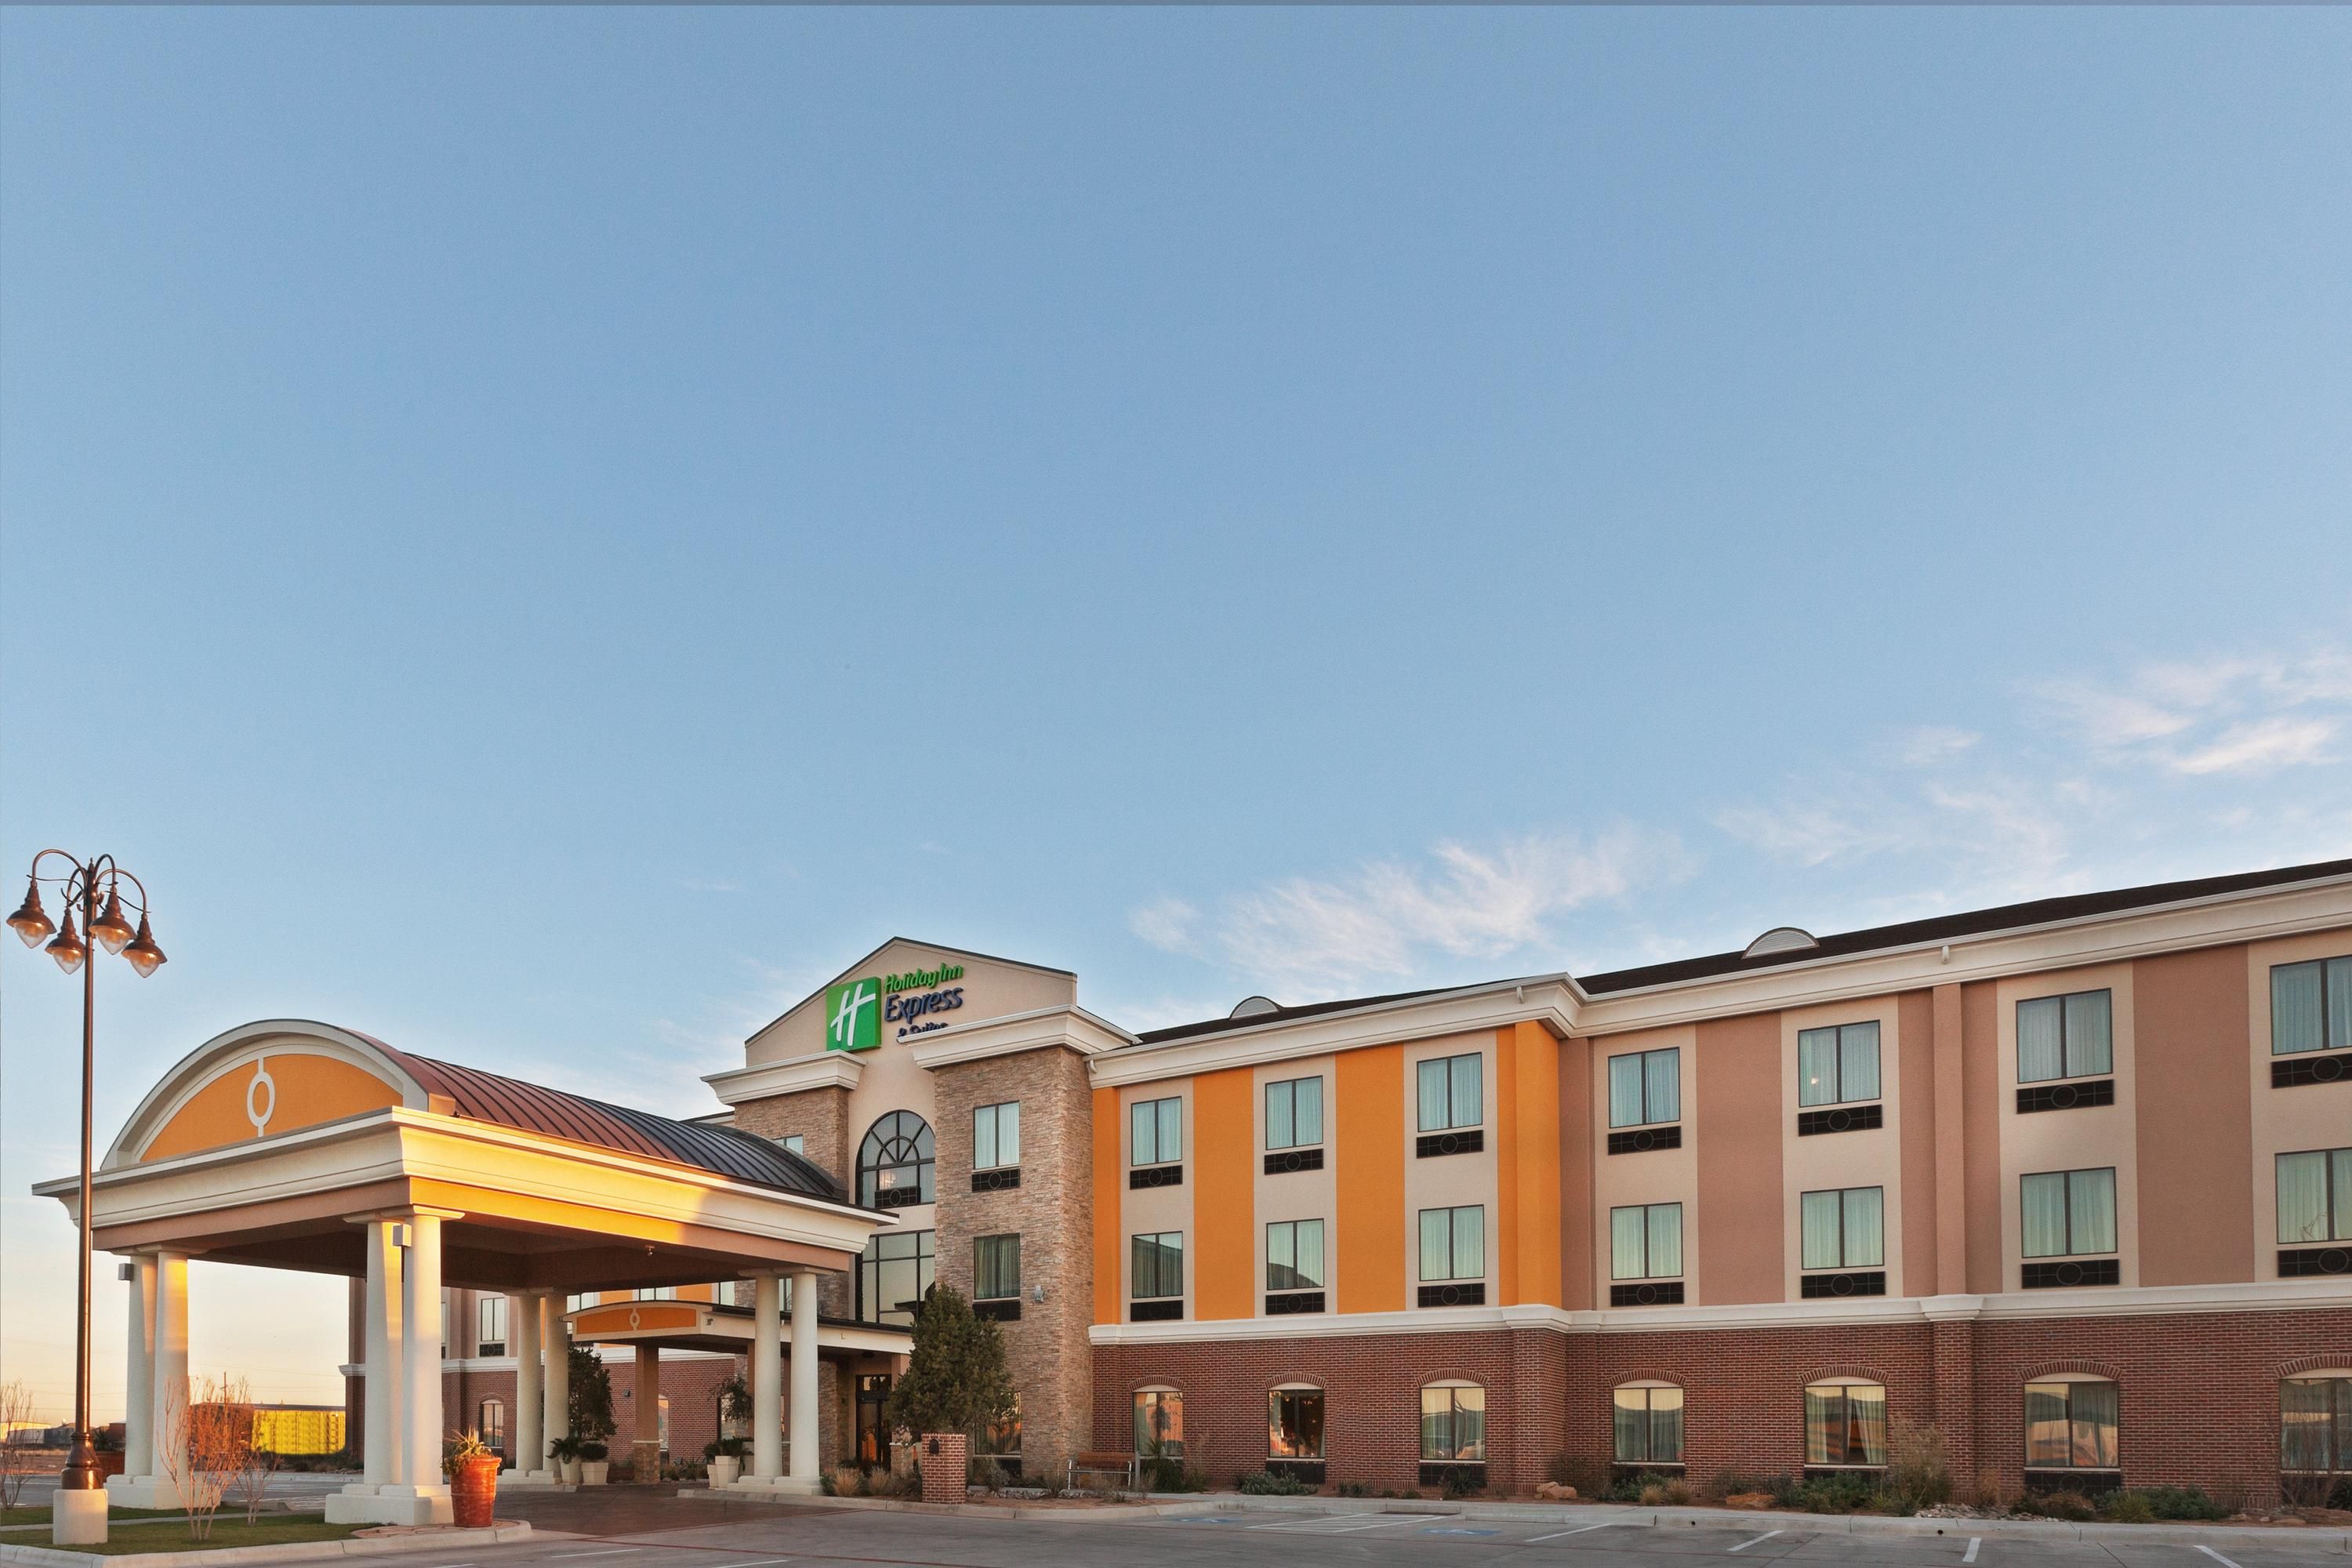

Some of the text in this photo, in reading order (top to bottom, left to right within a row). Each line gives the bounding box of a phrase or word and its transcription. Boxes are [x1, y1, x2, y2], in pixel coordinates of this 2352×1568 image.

[884, 961, 964, 994] Holiday Inn
[884, 987, 964, 1025] Express
